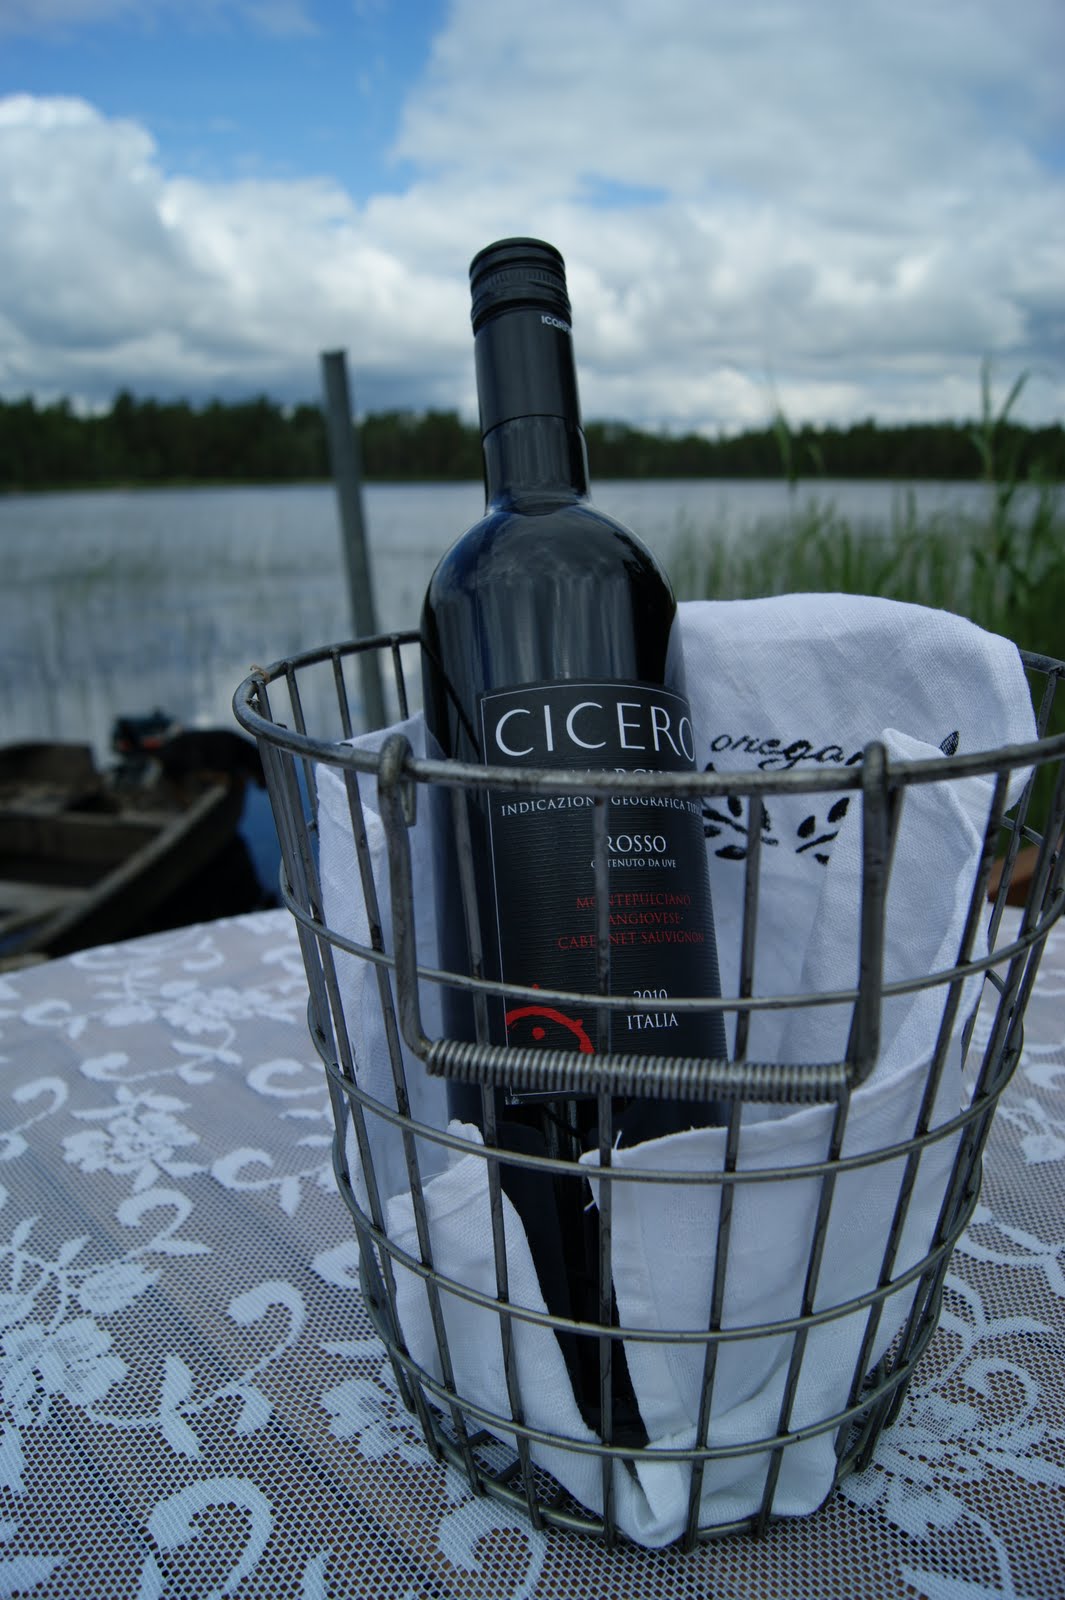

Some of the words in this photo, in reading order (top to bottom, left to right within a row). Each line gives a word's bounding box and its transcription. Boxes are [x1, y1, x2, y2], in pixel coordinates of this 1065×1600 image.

[495, 701, 695, 763] CICERO
[501, 796, 599, 817] INDICAZION
[611, 796, 686, 811] GEOGRAFICA
[590, 858, 646, 868] OTENUTO
[647, 858, 660, 868] DA
[662, 858, 677, 868] UVE
[557, 931, 637, 950] CABENET
[641, 929, 705, 945] SAUVIGNON
[627, 1012, 679, 1030] ITALIA
